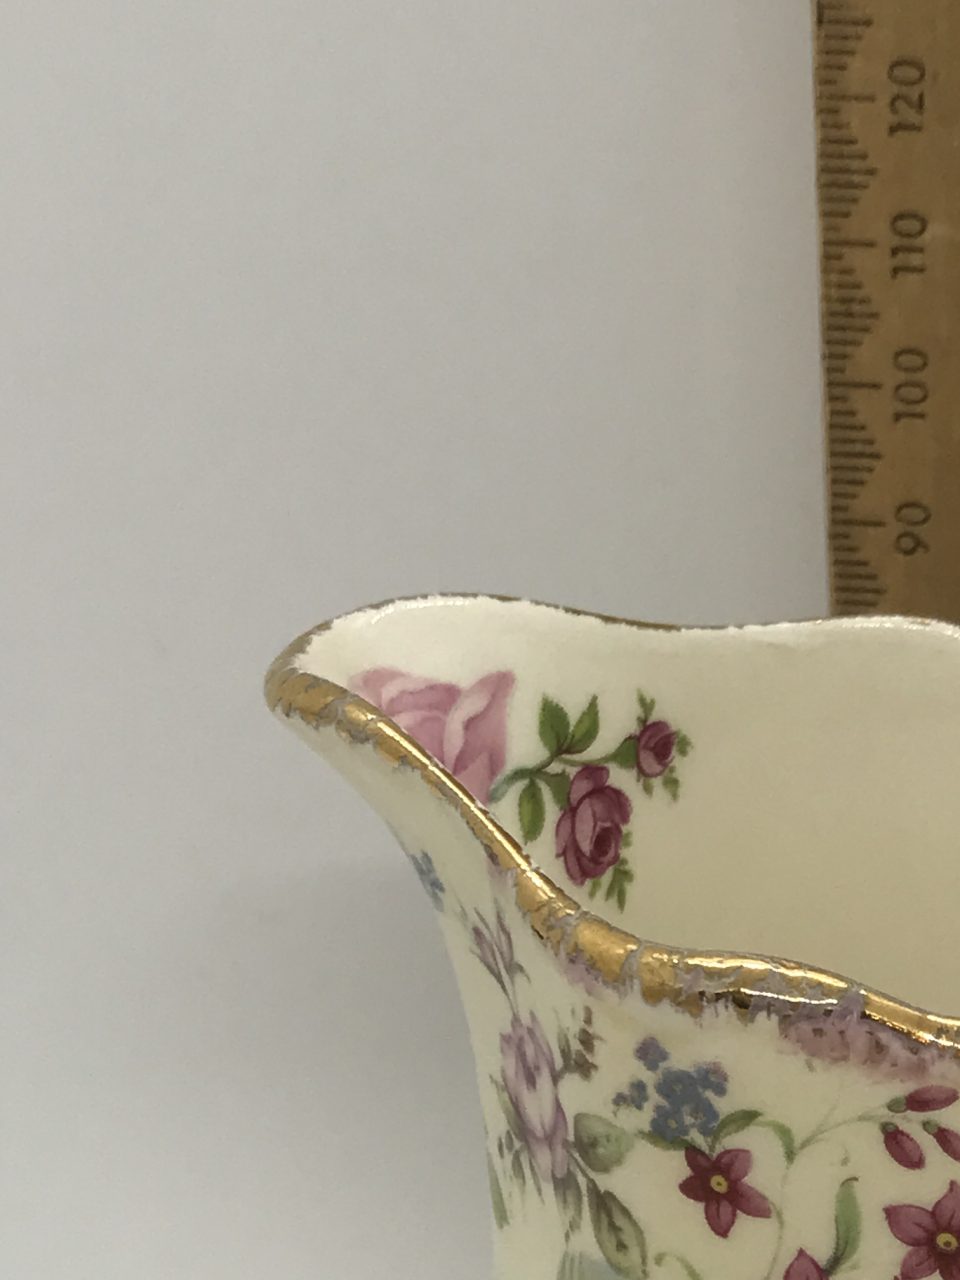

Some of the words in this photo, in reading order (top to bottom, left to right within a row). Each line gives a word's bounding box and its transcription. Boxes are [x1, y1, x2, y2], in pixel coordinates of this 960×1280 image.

[887, 57, 926, 137] 120
[890, 211, 928, 280] 110
[892, 347, 929, 423] 100
[894, 501, 932, 556] 90
